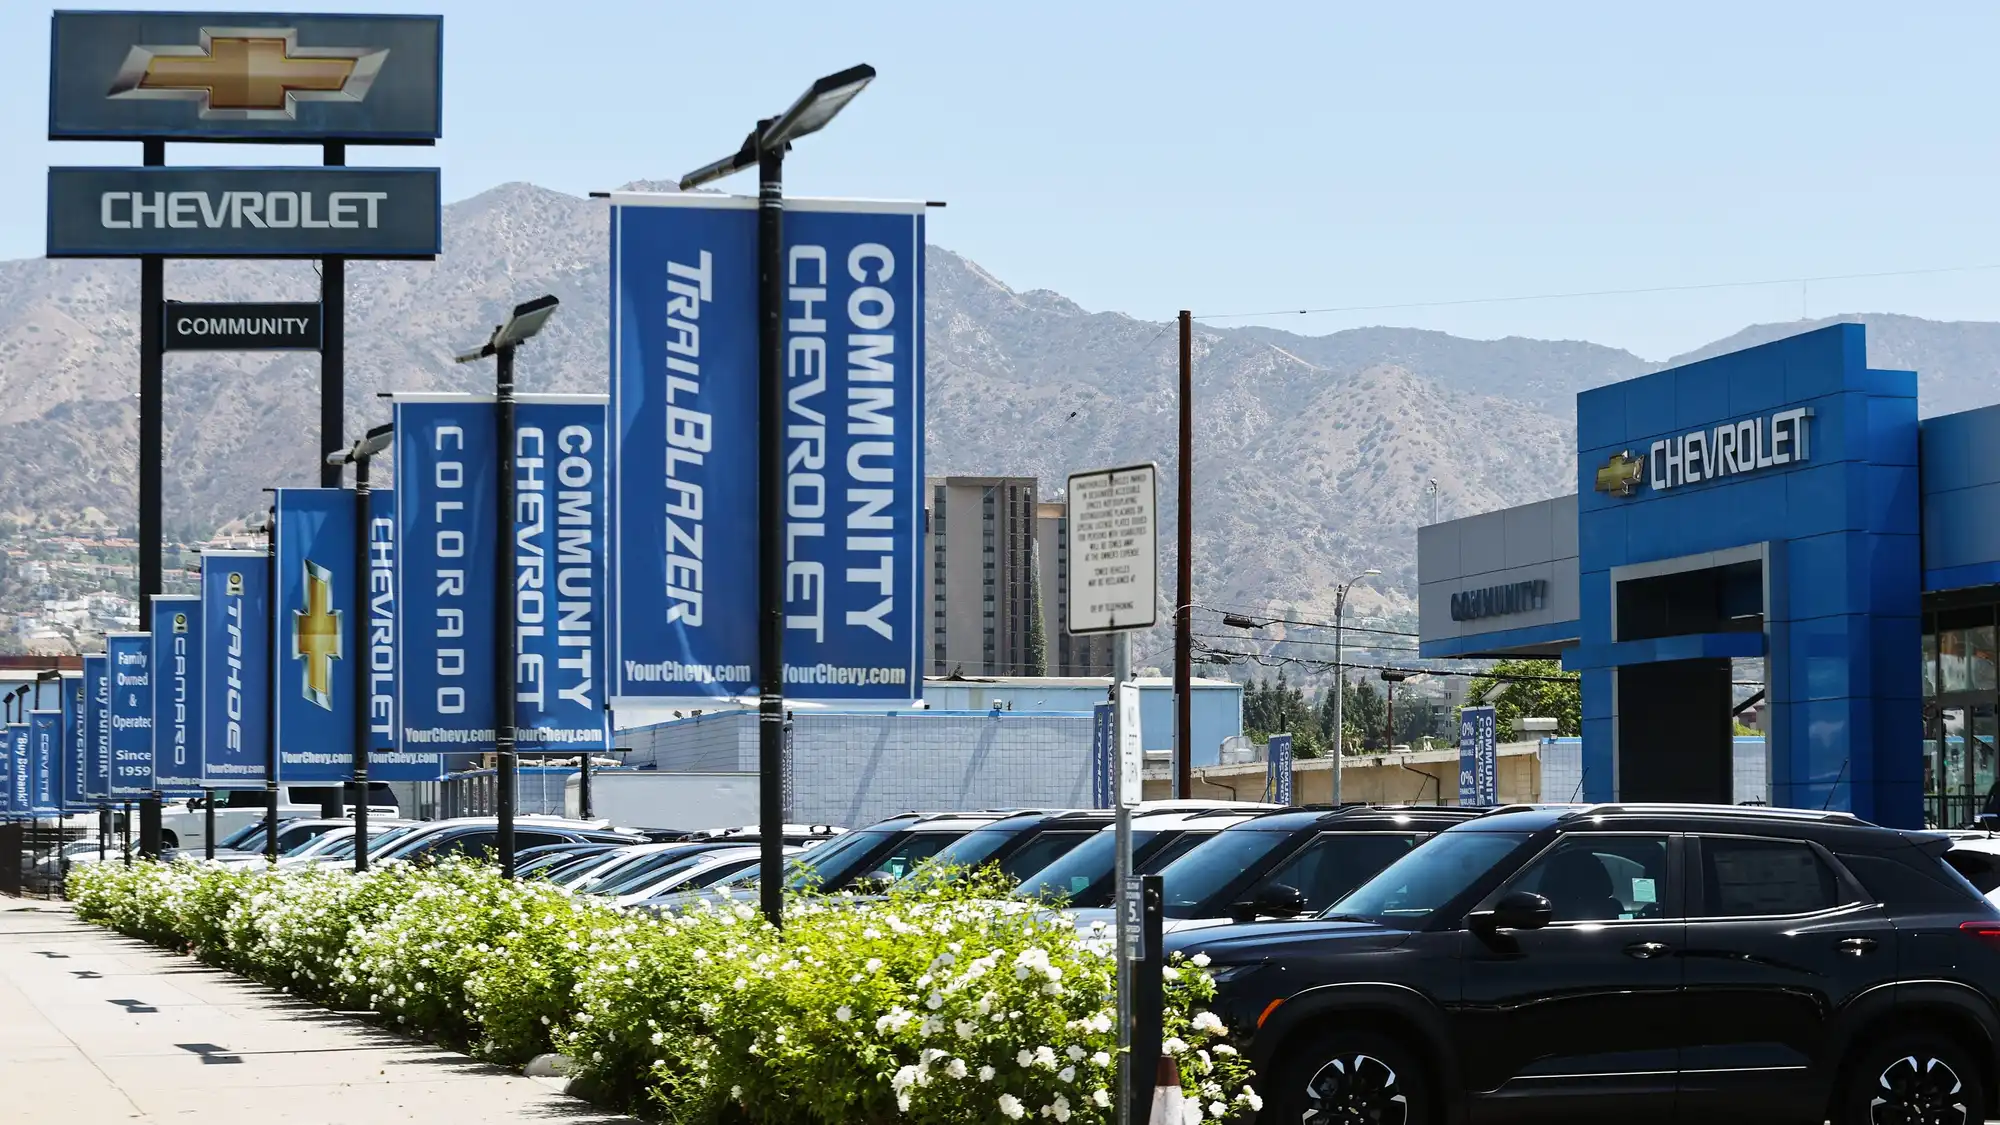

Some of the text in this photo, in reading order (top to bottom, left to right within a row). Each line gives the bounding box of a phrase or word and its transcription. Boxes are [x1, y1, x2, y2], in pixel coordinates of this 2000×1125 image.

[101, 191, 388, 229] CHEVROLET
[176, 317, 309, 336] COMMUNITY
[666, 249, 713, 628] TRAILBLAZER
[786, 244, 827, 643] CHEVROLET
[846, 242, 896, 641] COMMUNITY
[1650, 406, 1811, 490] CHEVROLET
[435, 426, 465, 714] COLORADO
[516, 427, 545, 713] CHEVROLET
[557, 424, 593, 711] COMMUNITY
[1451, 579, 1547, 621] COMMUNITY
[371, 517, 394, 741] CHEVROLET
[118, 651, 148, 668] Family
[117, 672, 149, 686] Owned
[226, 597, 242, 752] TAHOE
[624, 660, 751, 684] YourChevy.com
[128, 693, 138, 707] &
[174, 637, 186, 765] CAMARO
[405, 727, 496, 744] YourChevy.com
[1462, 722, 1474, 736] 0%
[40, 733, 49, 802] CORVETTE
[116, 750, 152, 761] Since
[281, 751, 353, 766] YourChevy.com
[367, 751, 438, 765] YourChevy.com
[1485, 716, 1494, 804] COMMUNIT
[118, 766, 151, 777] 1959
[156, 776, 200, 786] YourChevy.co
[206, 763, 265, 775] YourChevy.com
[1460, 771, 1473, 785] 0%
[1128, 901, 1137, 923] 5
